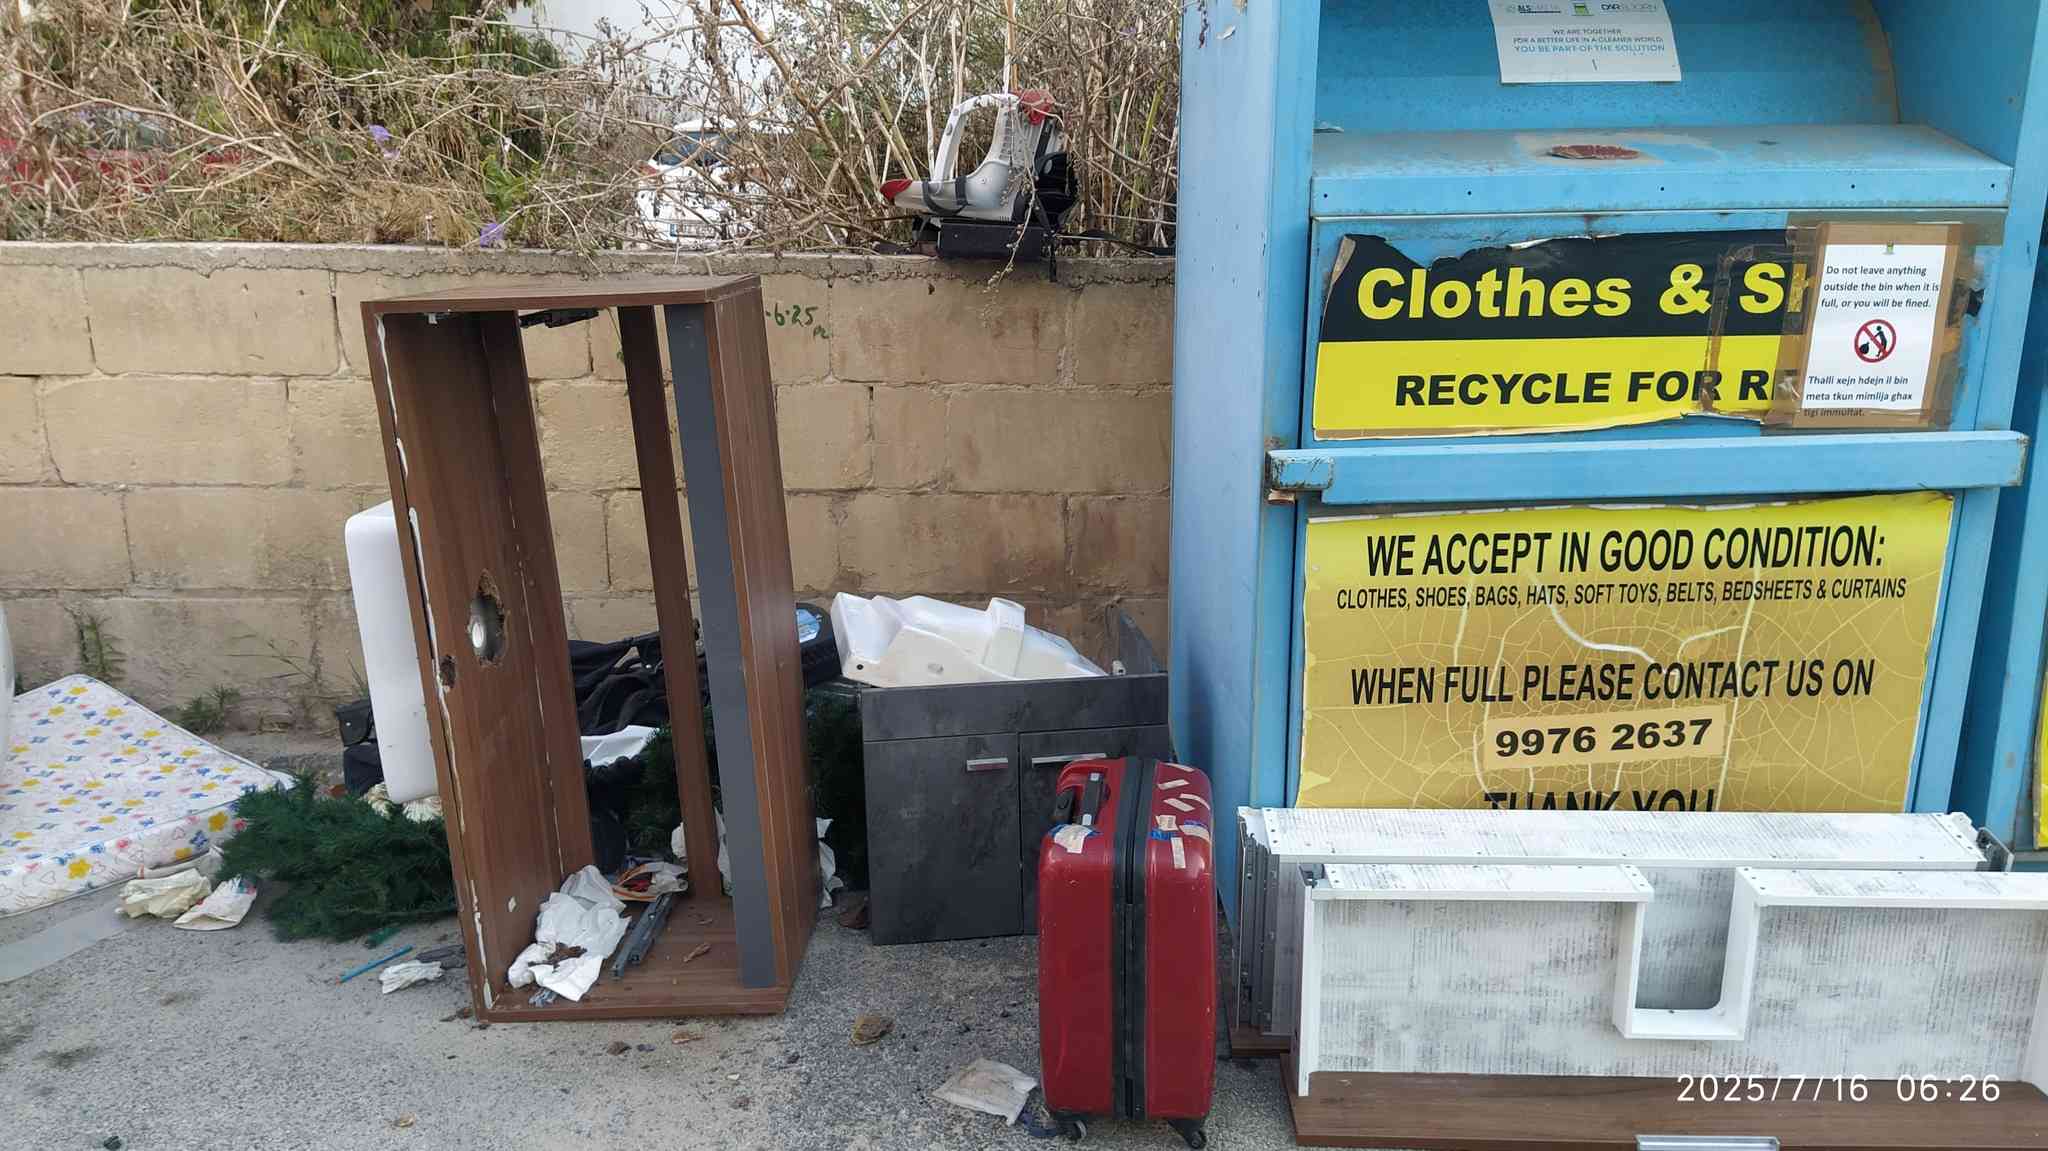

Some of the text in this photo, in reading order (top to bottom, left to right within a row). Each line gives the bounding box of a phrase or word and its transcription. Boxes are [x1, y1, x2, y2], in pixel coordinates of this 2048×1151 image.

[1514, 45, 1665, 53] YOU BE PART OF THE SOLUTION
[1826, 266, 1927, 276] Do not leave anything
[1357, 267, 1632, 320] Clothes
[1659, 263, 1711, 315] &
[1824, 282, 1939, 292] outside the bin when it is
[1821, 299, 1932, 309] full, or you will be fined.
[1395, 371, 1611, 406] RECYCLE
[1627, 370, 1722, 402] FOR
[1808, 376, 1909, 385] Thalli xejn hdejn il bin
[1806, 392, 1830, 401] meta
[1832, 392, 1854, 401] tkun
[1856, 392, 1889, 401] mimlija
[1366, 525, 1885, 576] WE ACCEPT IN GOOD CONDITION:
[1337, 577, 1906, 611] CLOTHES, SHOES, BAGS, HATS, SOFT TOYS, BELTS, BEDSHEETS & CURTAINS
[1351, 658, 1874, 705] WHEN FULL PLEASE CONTACT US ON
[1495, 718, 1713, 758] 9976 2637
